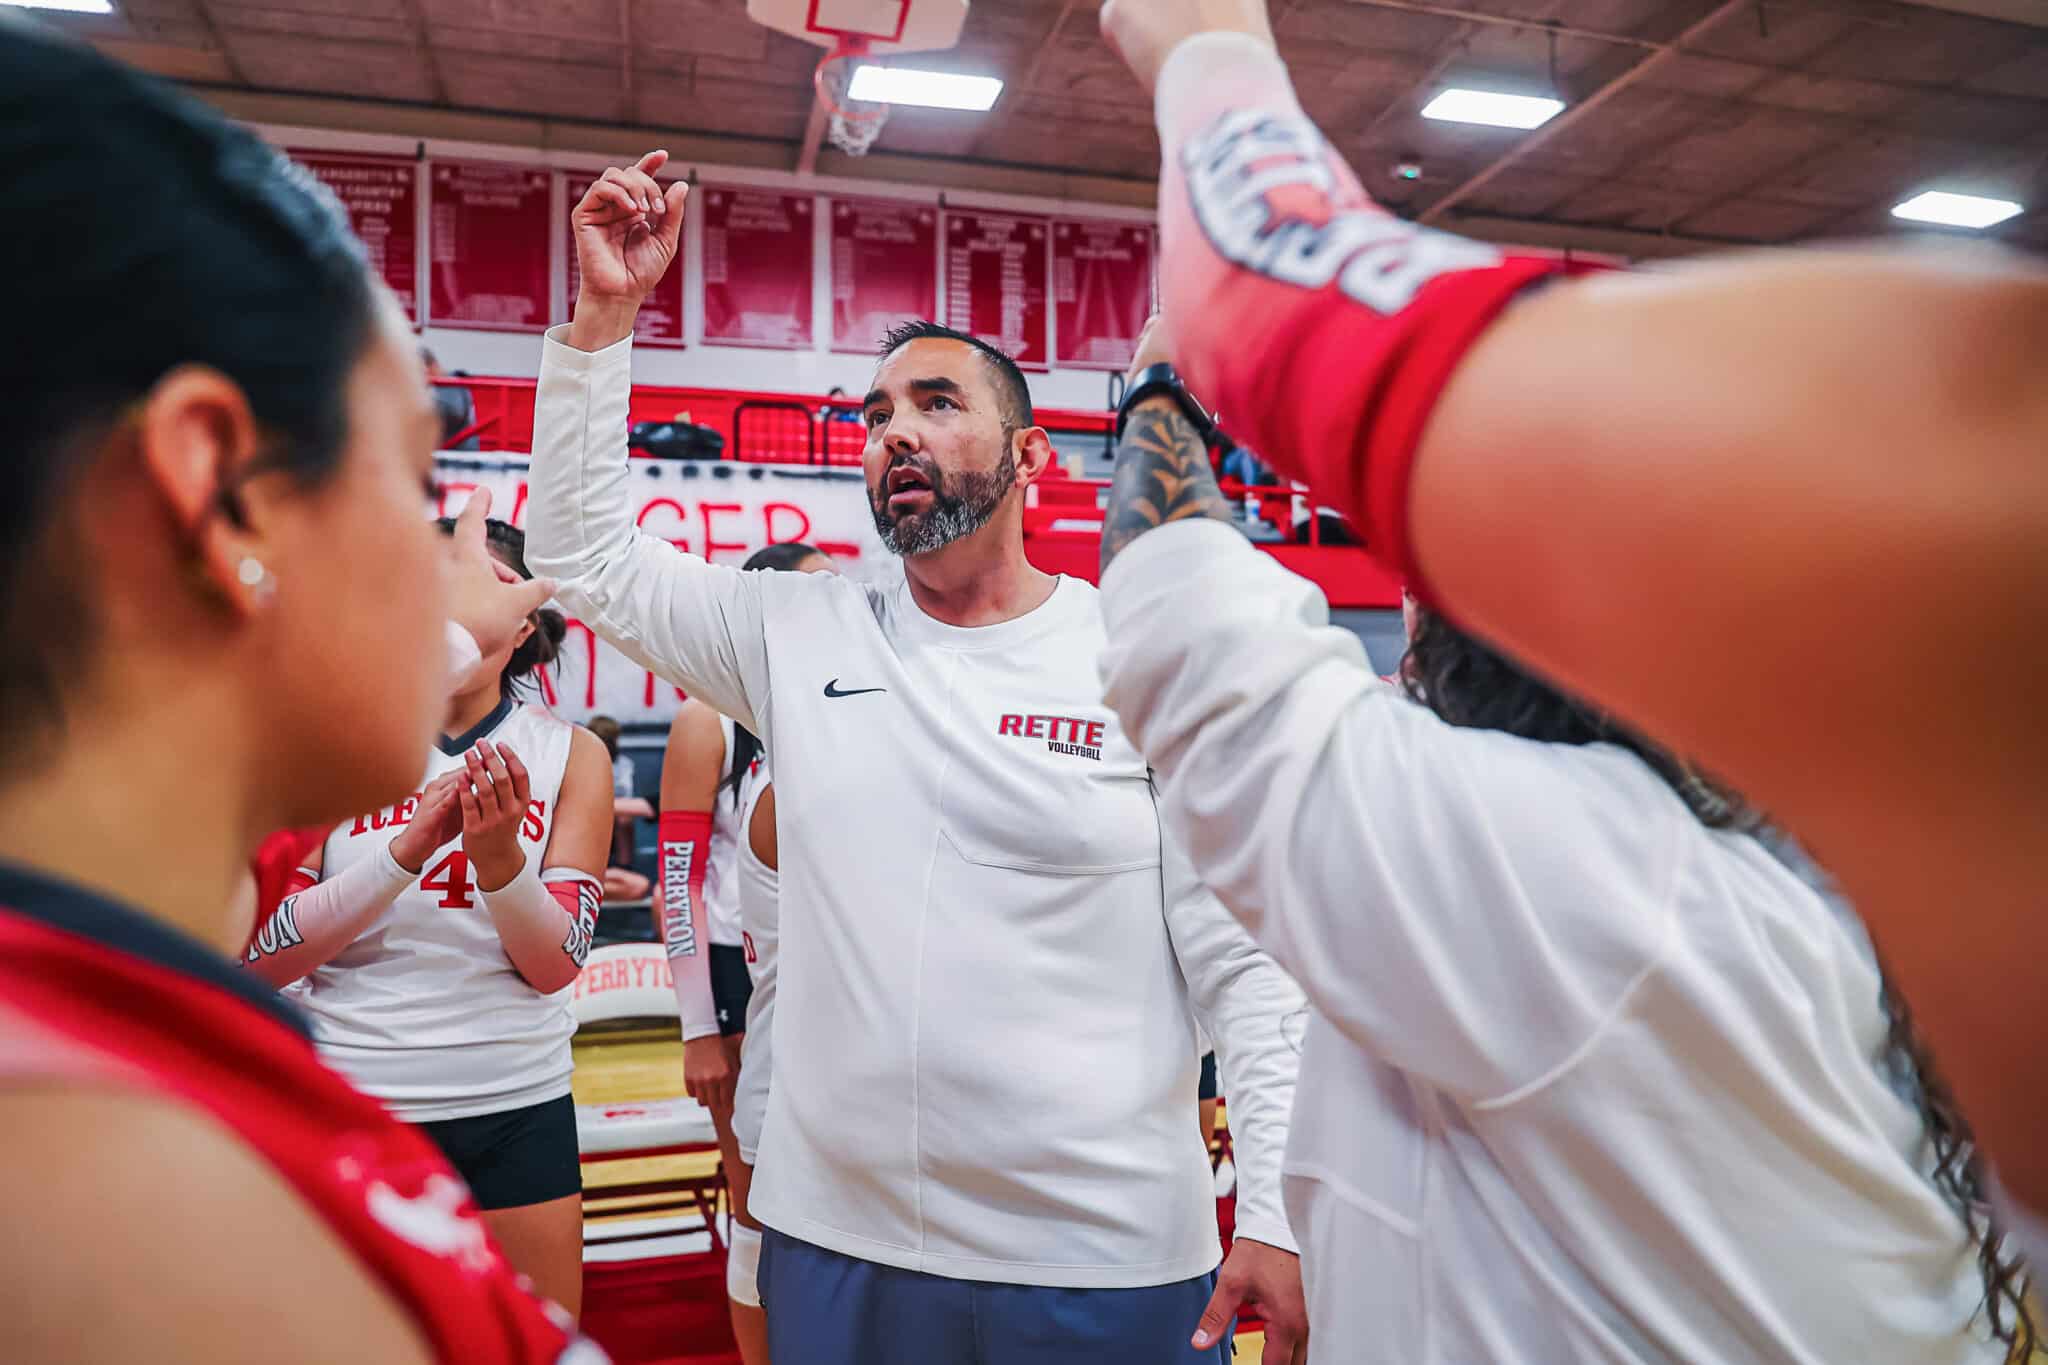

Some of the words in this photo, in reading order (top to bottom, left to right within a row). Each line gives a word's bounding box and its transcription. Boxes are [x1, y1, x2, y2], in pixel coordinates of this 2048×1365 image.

[998, 714, 1106, 748] RETTE
[1047, 741, 1102, 761] VOLLEYBALL
[420, 850, 475, 909] 4
[662, 840, 696, 957] PERRYTON
